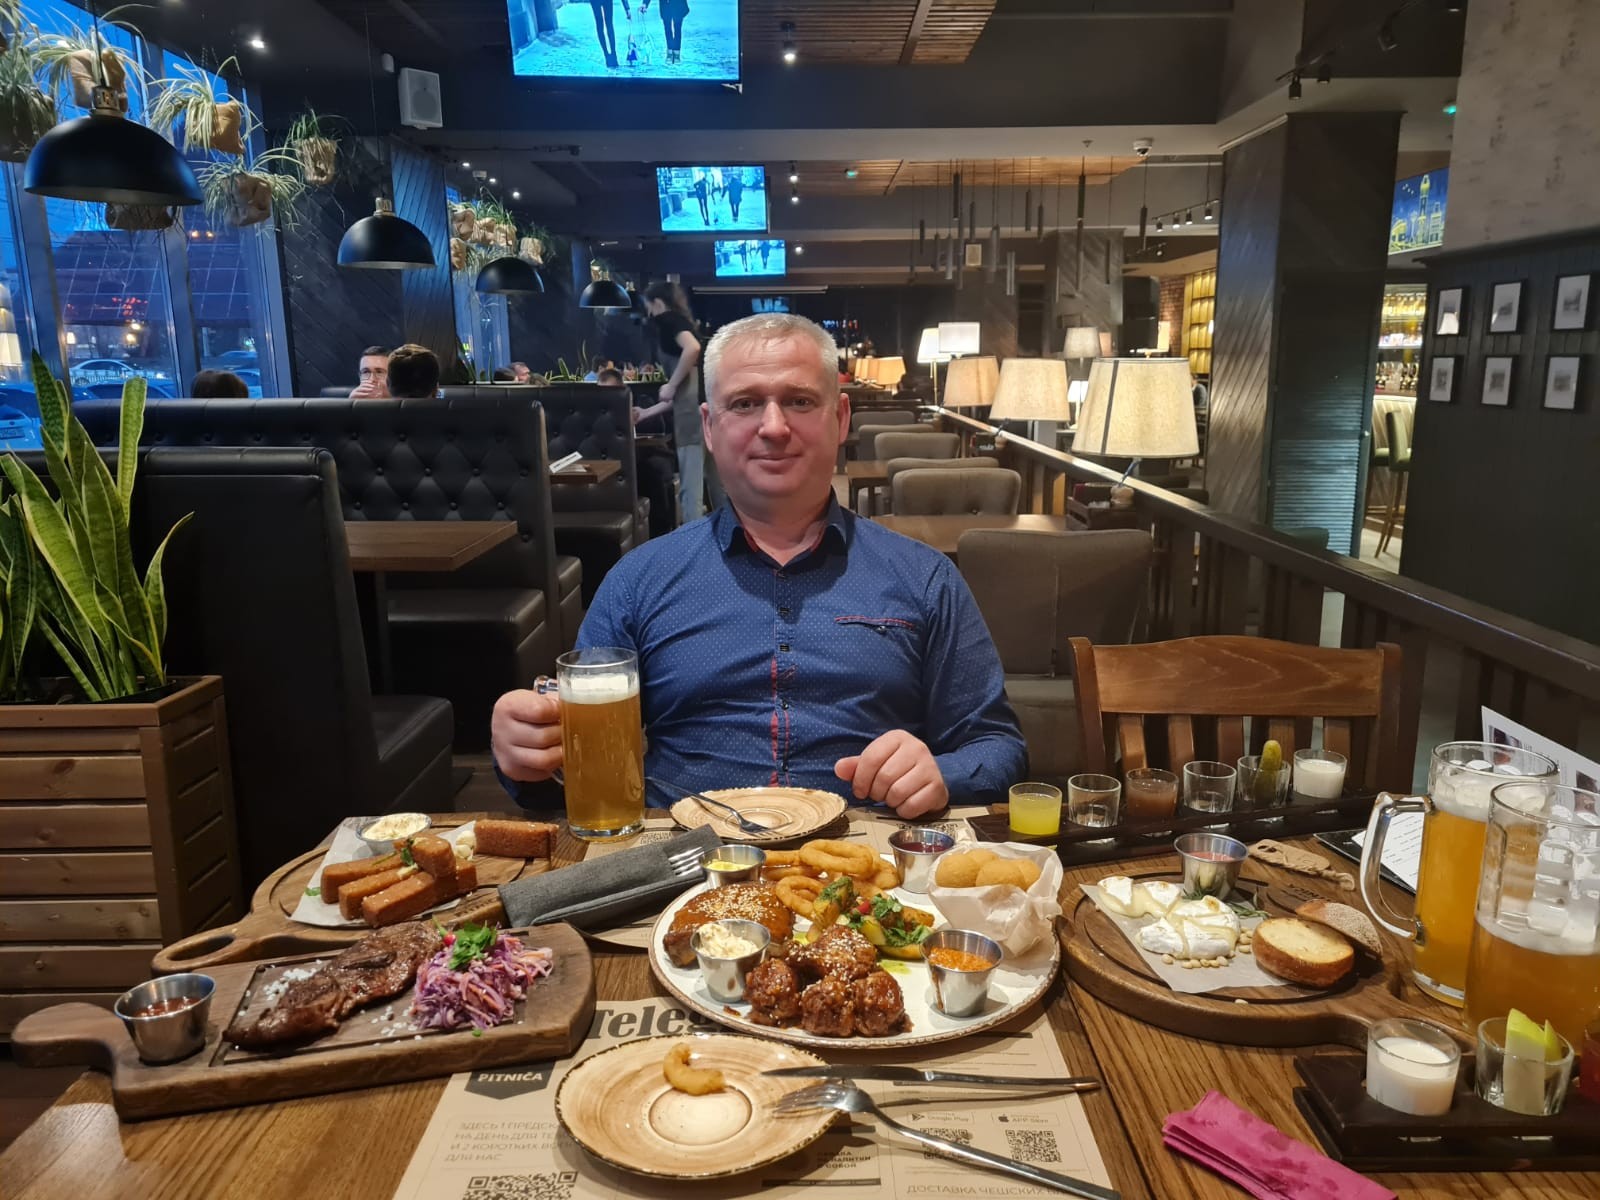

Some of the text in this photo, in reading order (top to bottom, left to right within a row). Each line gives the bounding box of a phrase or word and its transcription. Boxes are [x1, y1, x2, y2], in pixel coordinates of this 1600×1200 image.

[586, 1006, 718, 1038] Teleg
[507, 1121, 559, 1130] ПРЕДСК
[475, 1153, 504, 1161] НАС
[906, 1185, 977, 1195] ДОСТАВКА
[978, 1187, 1043, 1196] ЧЕШСКИХ
